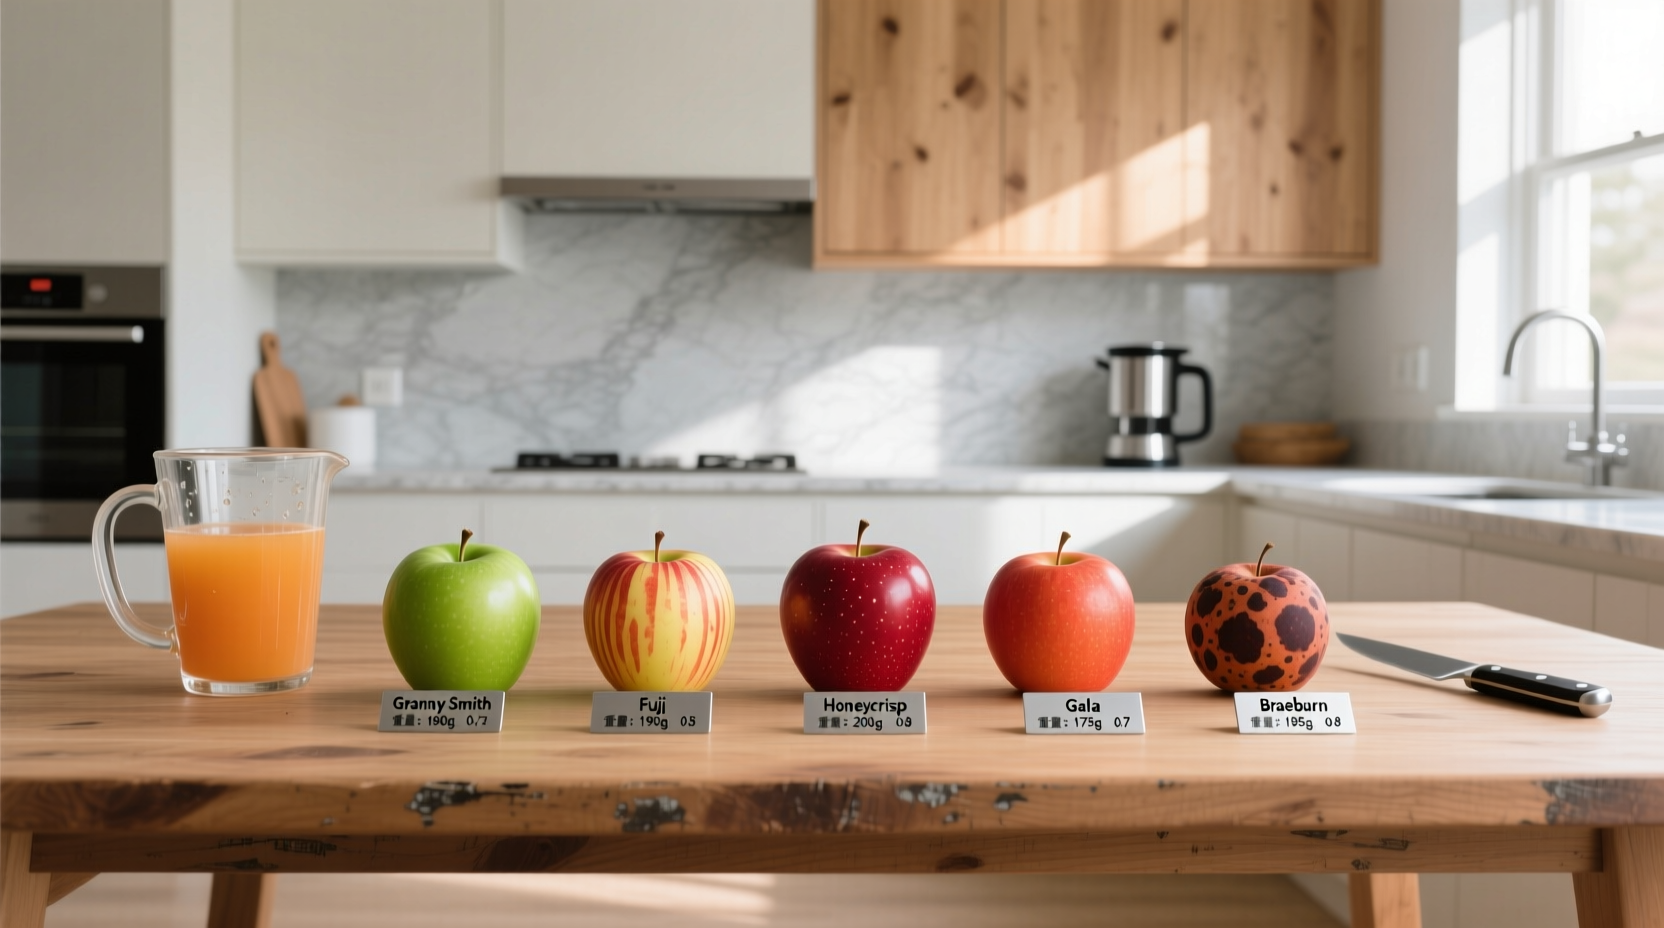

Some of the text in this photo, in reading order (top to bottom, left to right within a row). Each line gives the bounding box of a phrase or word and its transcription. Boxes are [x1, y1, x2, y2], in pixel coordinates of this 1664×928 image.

[392, 696, 492, 714] Granny Smith
[639, 696, 667, 715] Fuji
[823, 697, 908, 716] Honeycrisp
[1065, 698, 1101, 713] Gala
[1259, 696, 1328, 713] Braeburn
[427, 715, 456, 730] 190g
[639, 715, 669, 731] 190g
[852, 716, 883, 732] 200g
[1074, 716, 1103, 731] 175g
